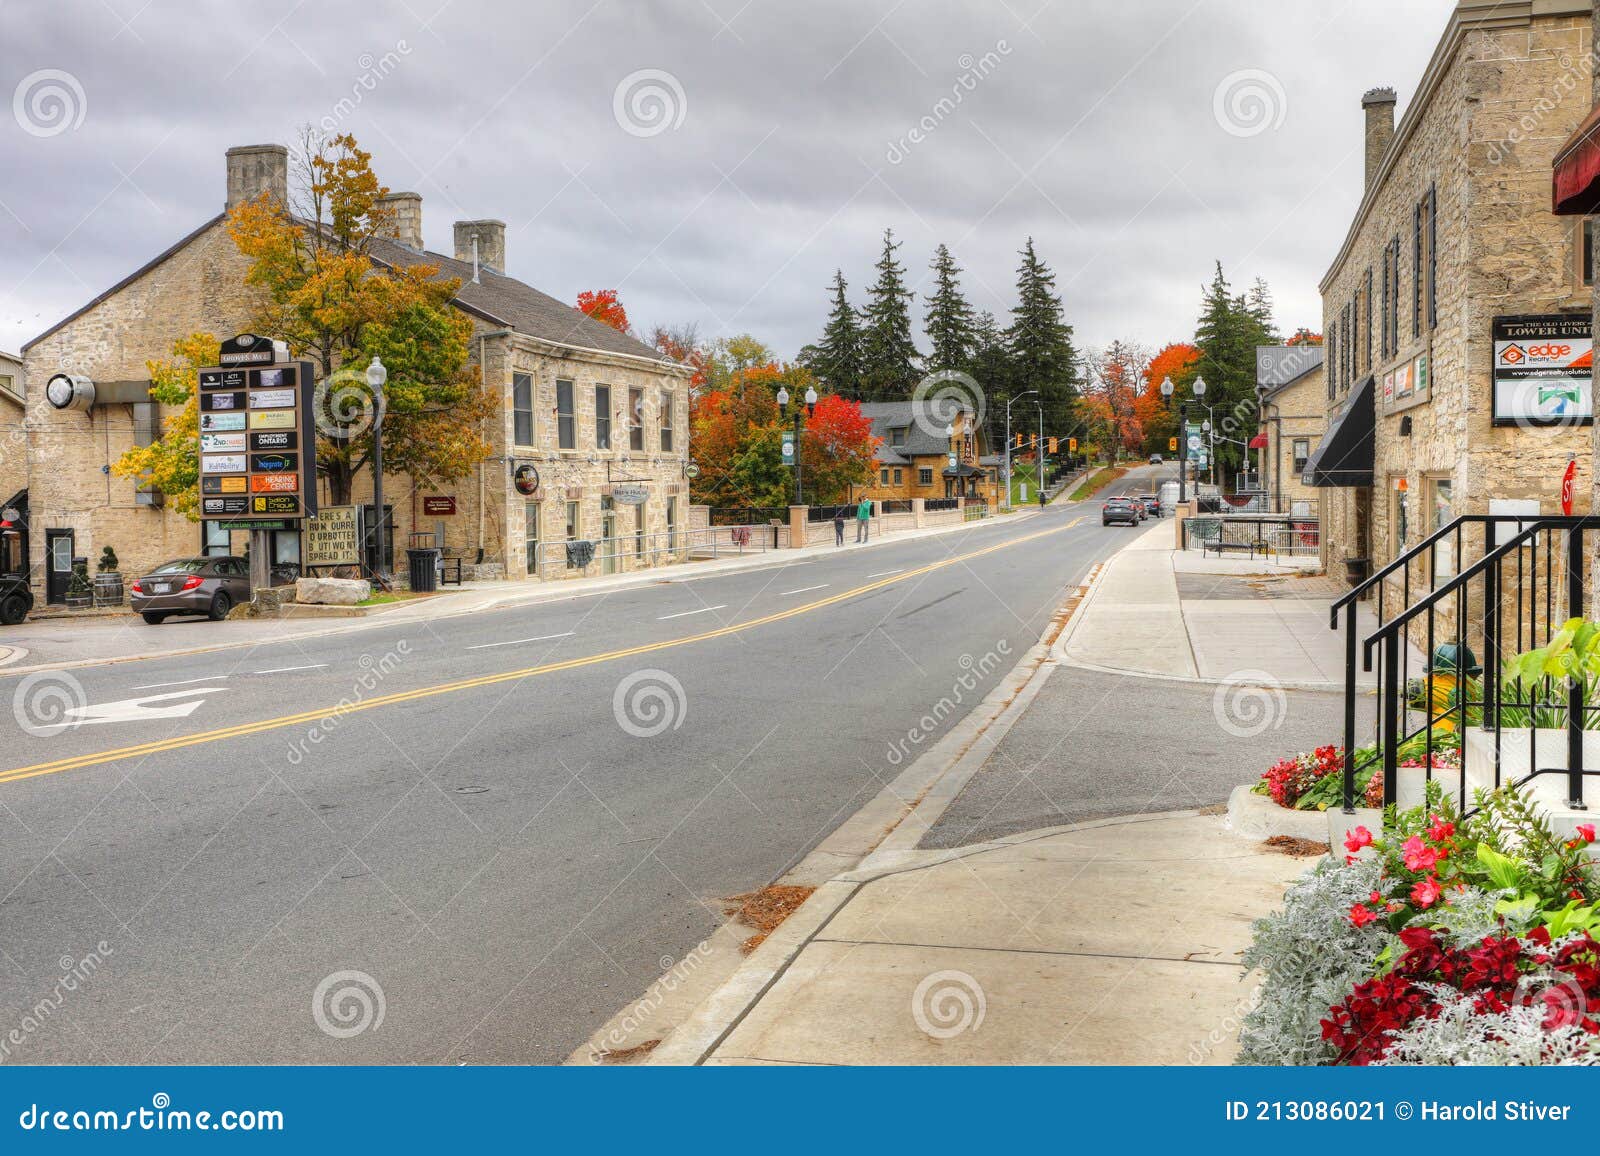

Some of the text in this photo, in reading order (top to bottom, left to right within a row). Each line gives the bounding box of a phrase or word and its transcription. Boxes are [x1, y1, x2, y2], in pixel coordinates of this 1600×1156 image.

[1506, 327, 1557, 336] LOWER
[239, 336, 253, 344] 160
[1528, 343, 1572, 360] edge
[258, 437, 288, 445] ONTARIO
[265, 475, 294, 483] HEARING
[270, 482, 296, 490] CENTRE
[308, 551, 339, 561] SPREAD
